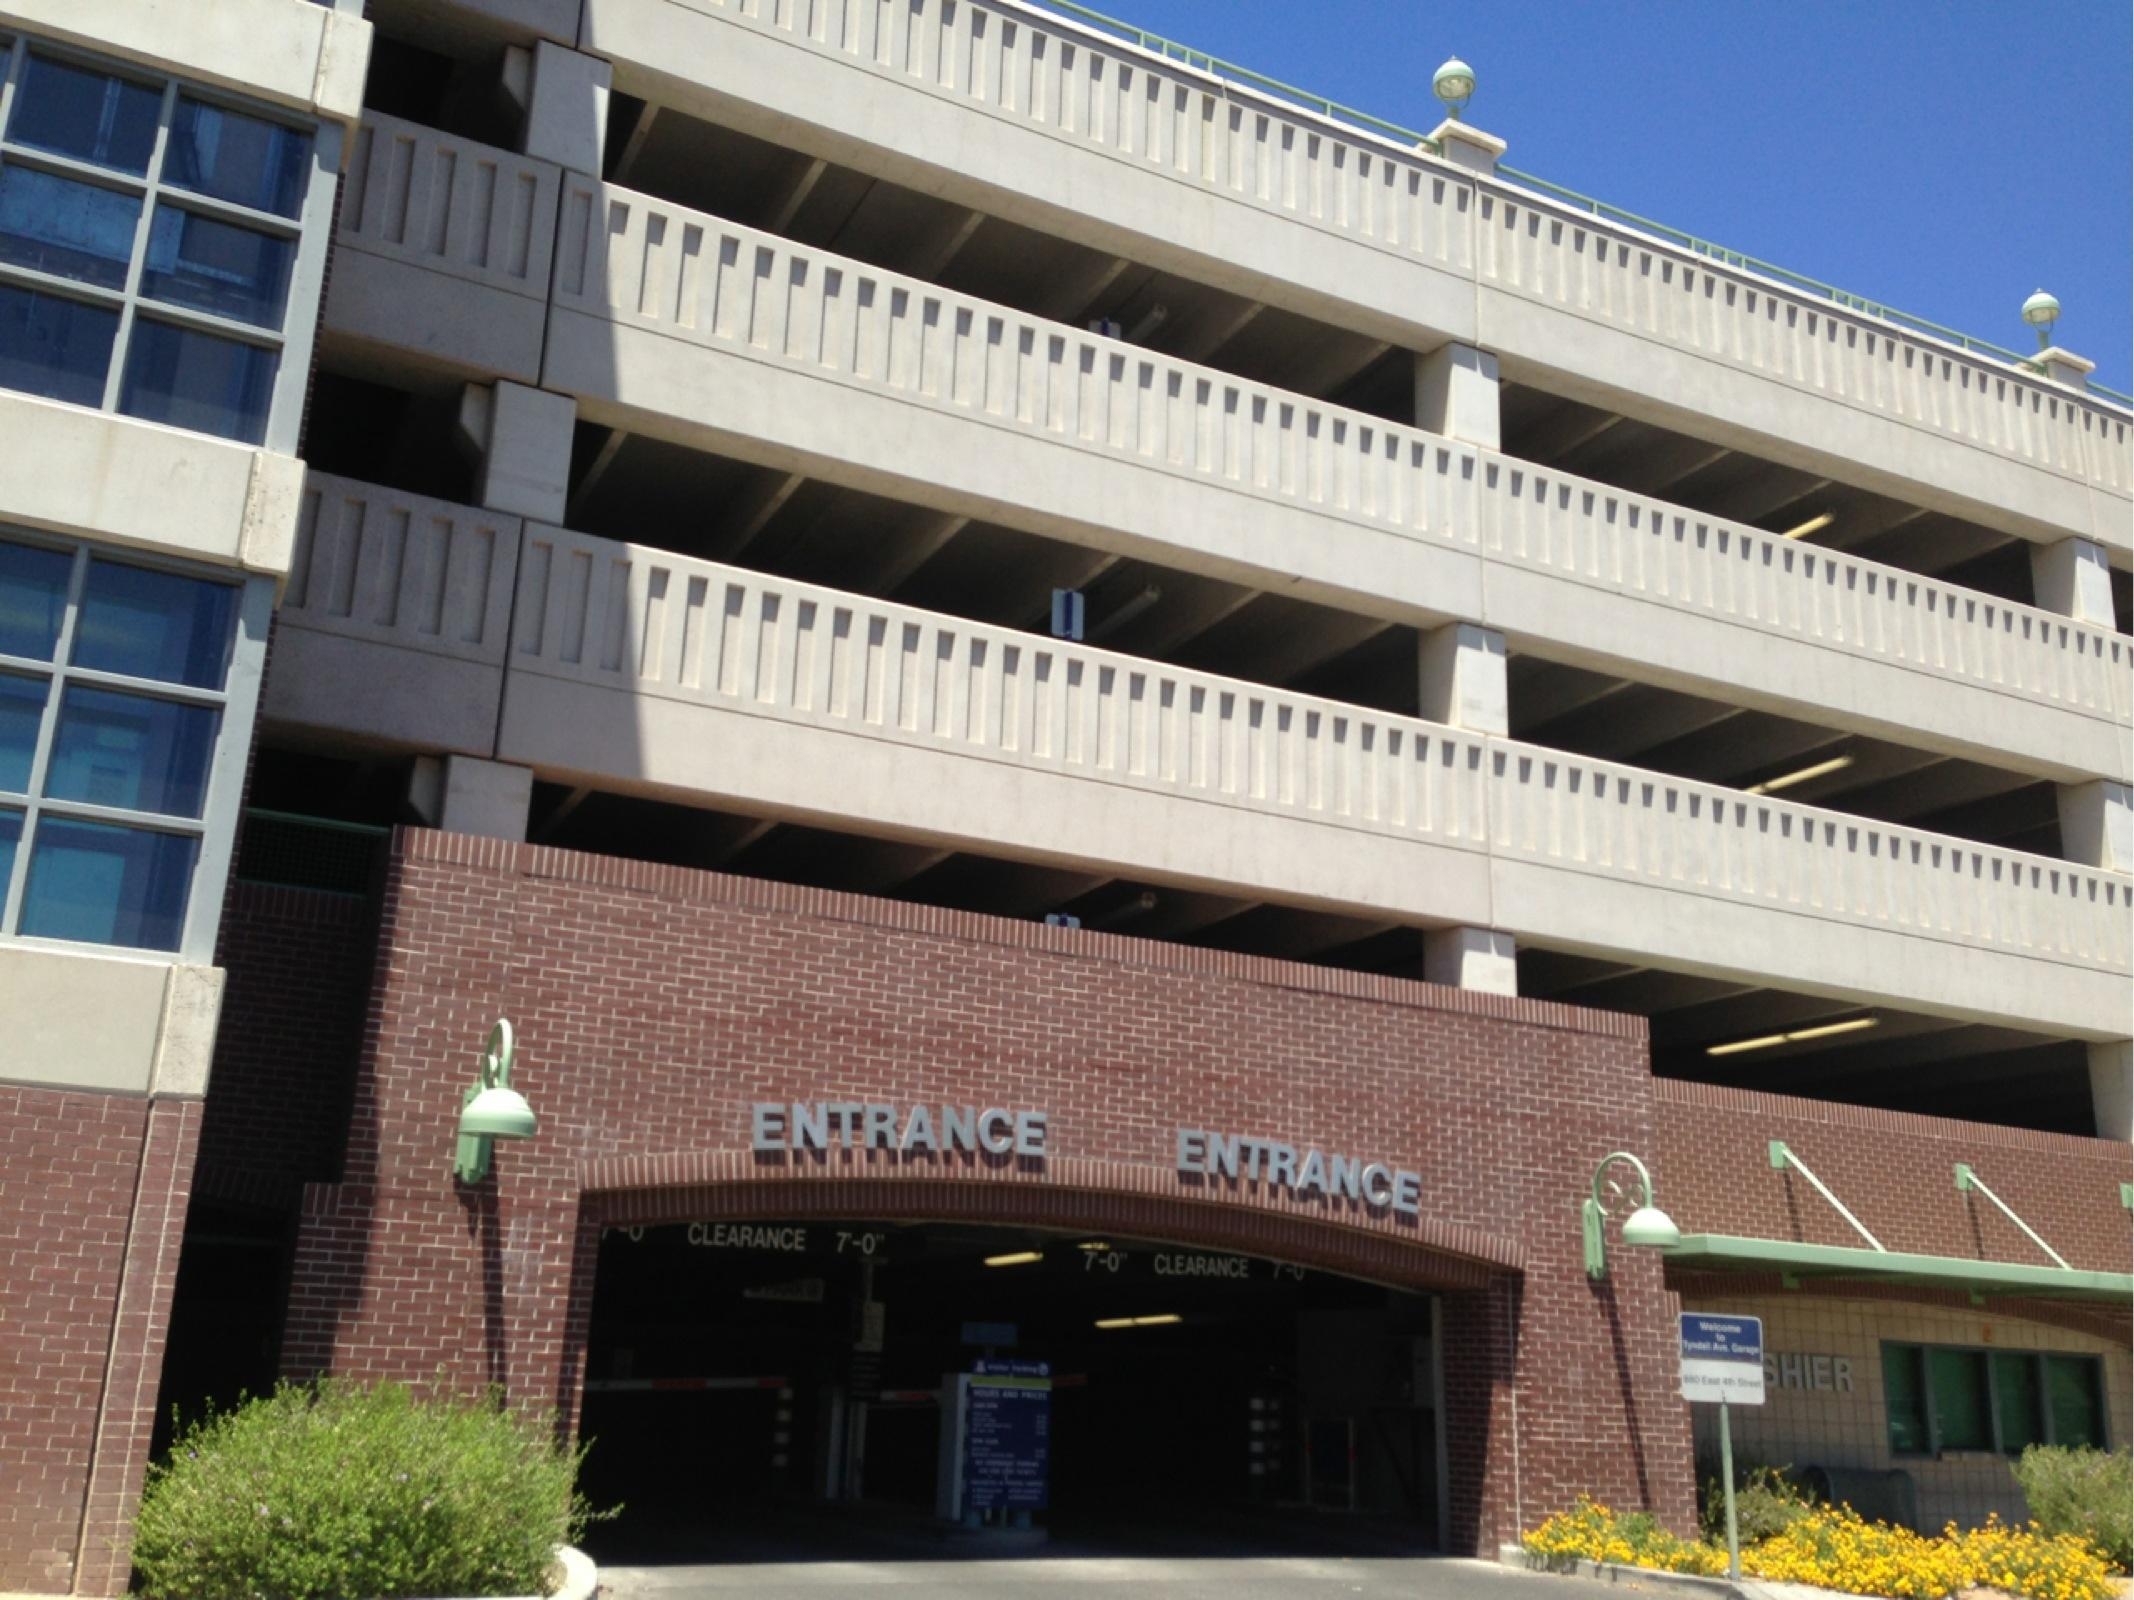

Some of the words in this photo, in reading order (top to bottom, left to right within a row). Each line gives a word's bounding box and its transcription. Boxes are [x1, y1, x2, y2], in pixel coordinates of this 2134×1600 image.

[752, 1102, 1047, 1156] ENTRANCE
[1176, 1129, 1421, 1214] ENTRANCE
[687, 1222, 806, 1251] CLEARANCE
[1154, 1253, 1249, 1277] CLEARANCE
[1699, 1321, 1741, 1333] Welcome
[1716, 1333, 1726, 1342] to
[1731, 1343, 1760, 1355] Garage
[1702, 1376, 1720, 1386] East
[1764, 1352, 1853, 1392] SHIER
